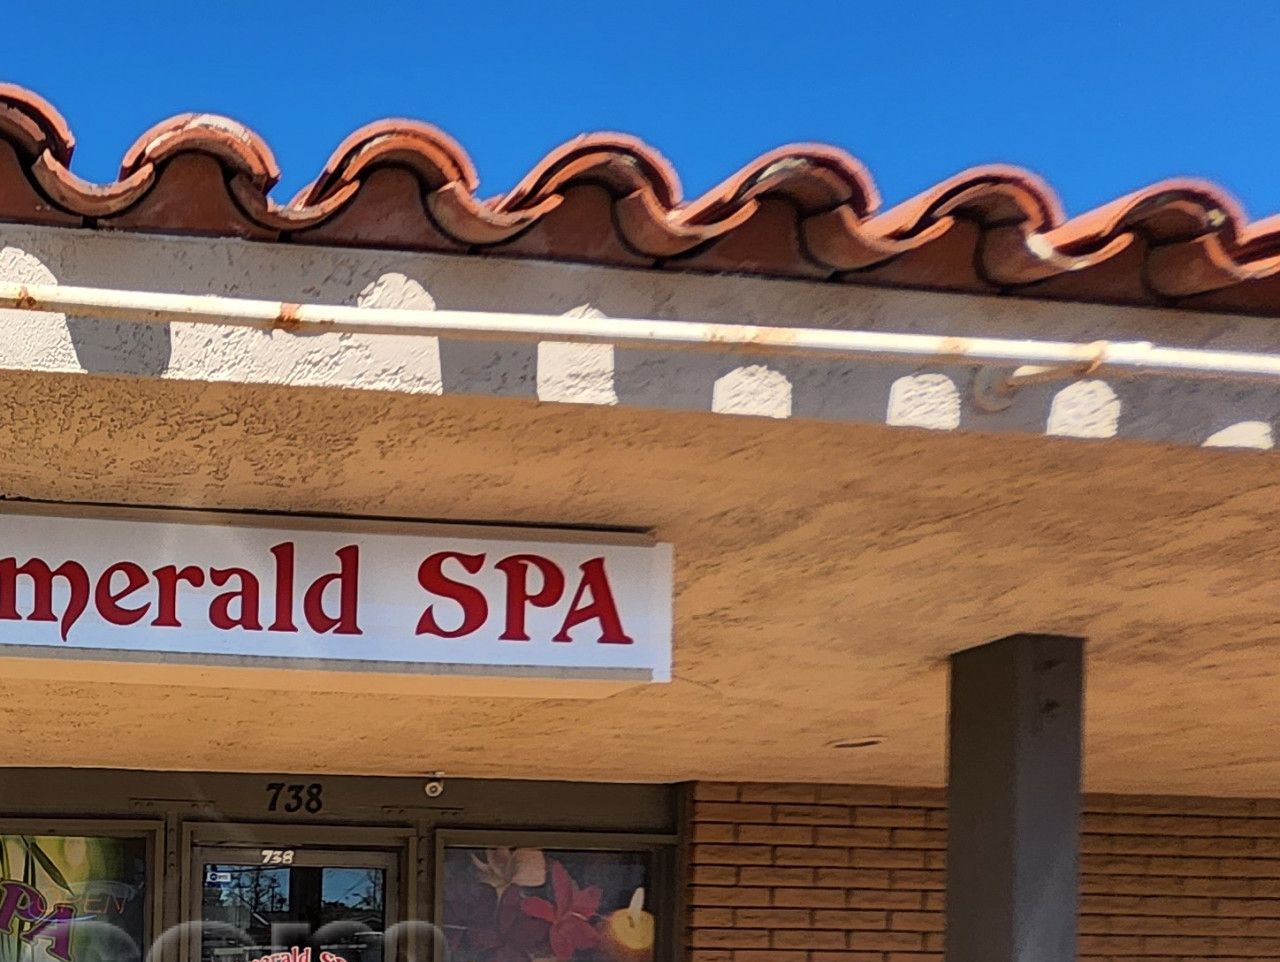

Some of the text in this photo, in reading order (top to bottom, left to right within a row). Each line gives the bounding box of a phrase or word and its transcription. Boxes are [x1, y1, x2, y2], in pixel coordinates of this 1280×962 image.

[416, 550, 635, 645] SPA
[266, 783, 323, 813] 738
[261, 850, 295, 864] 738
